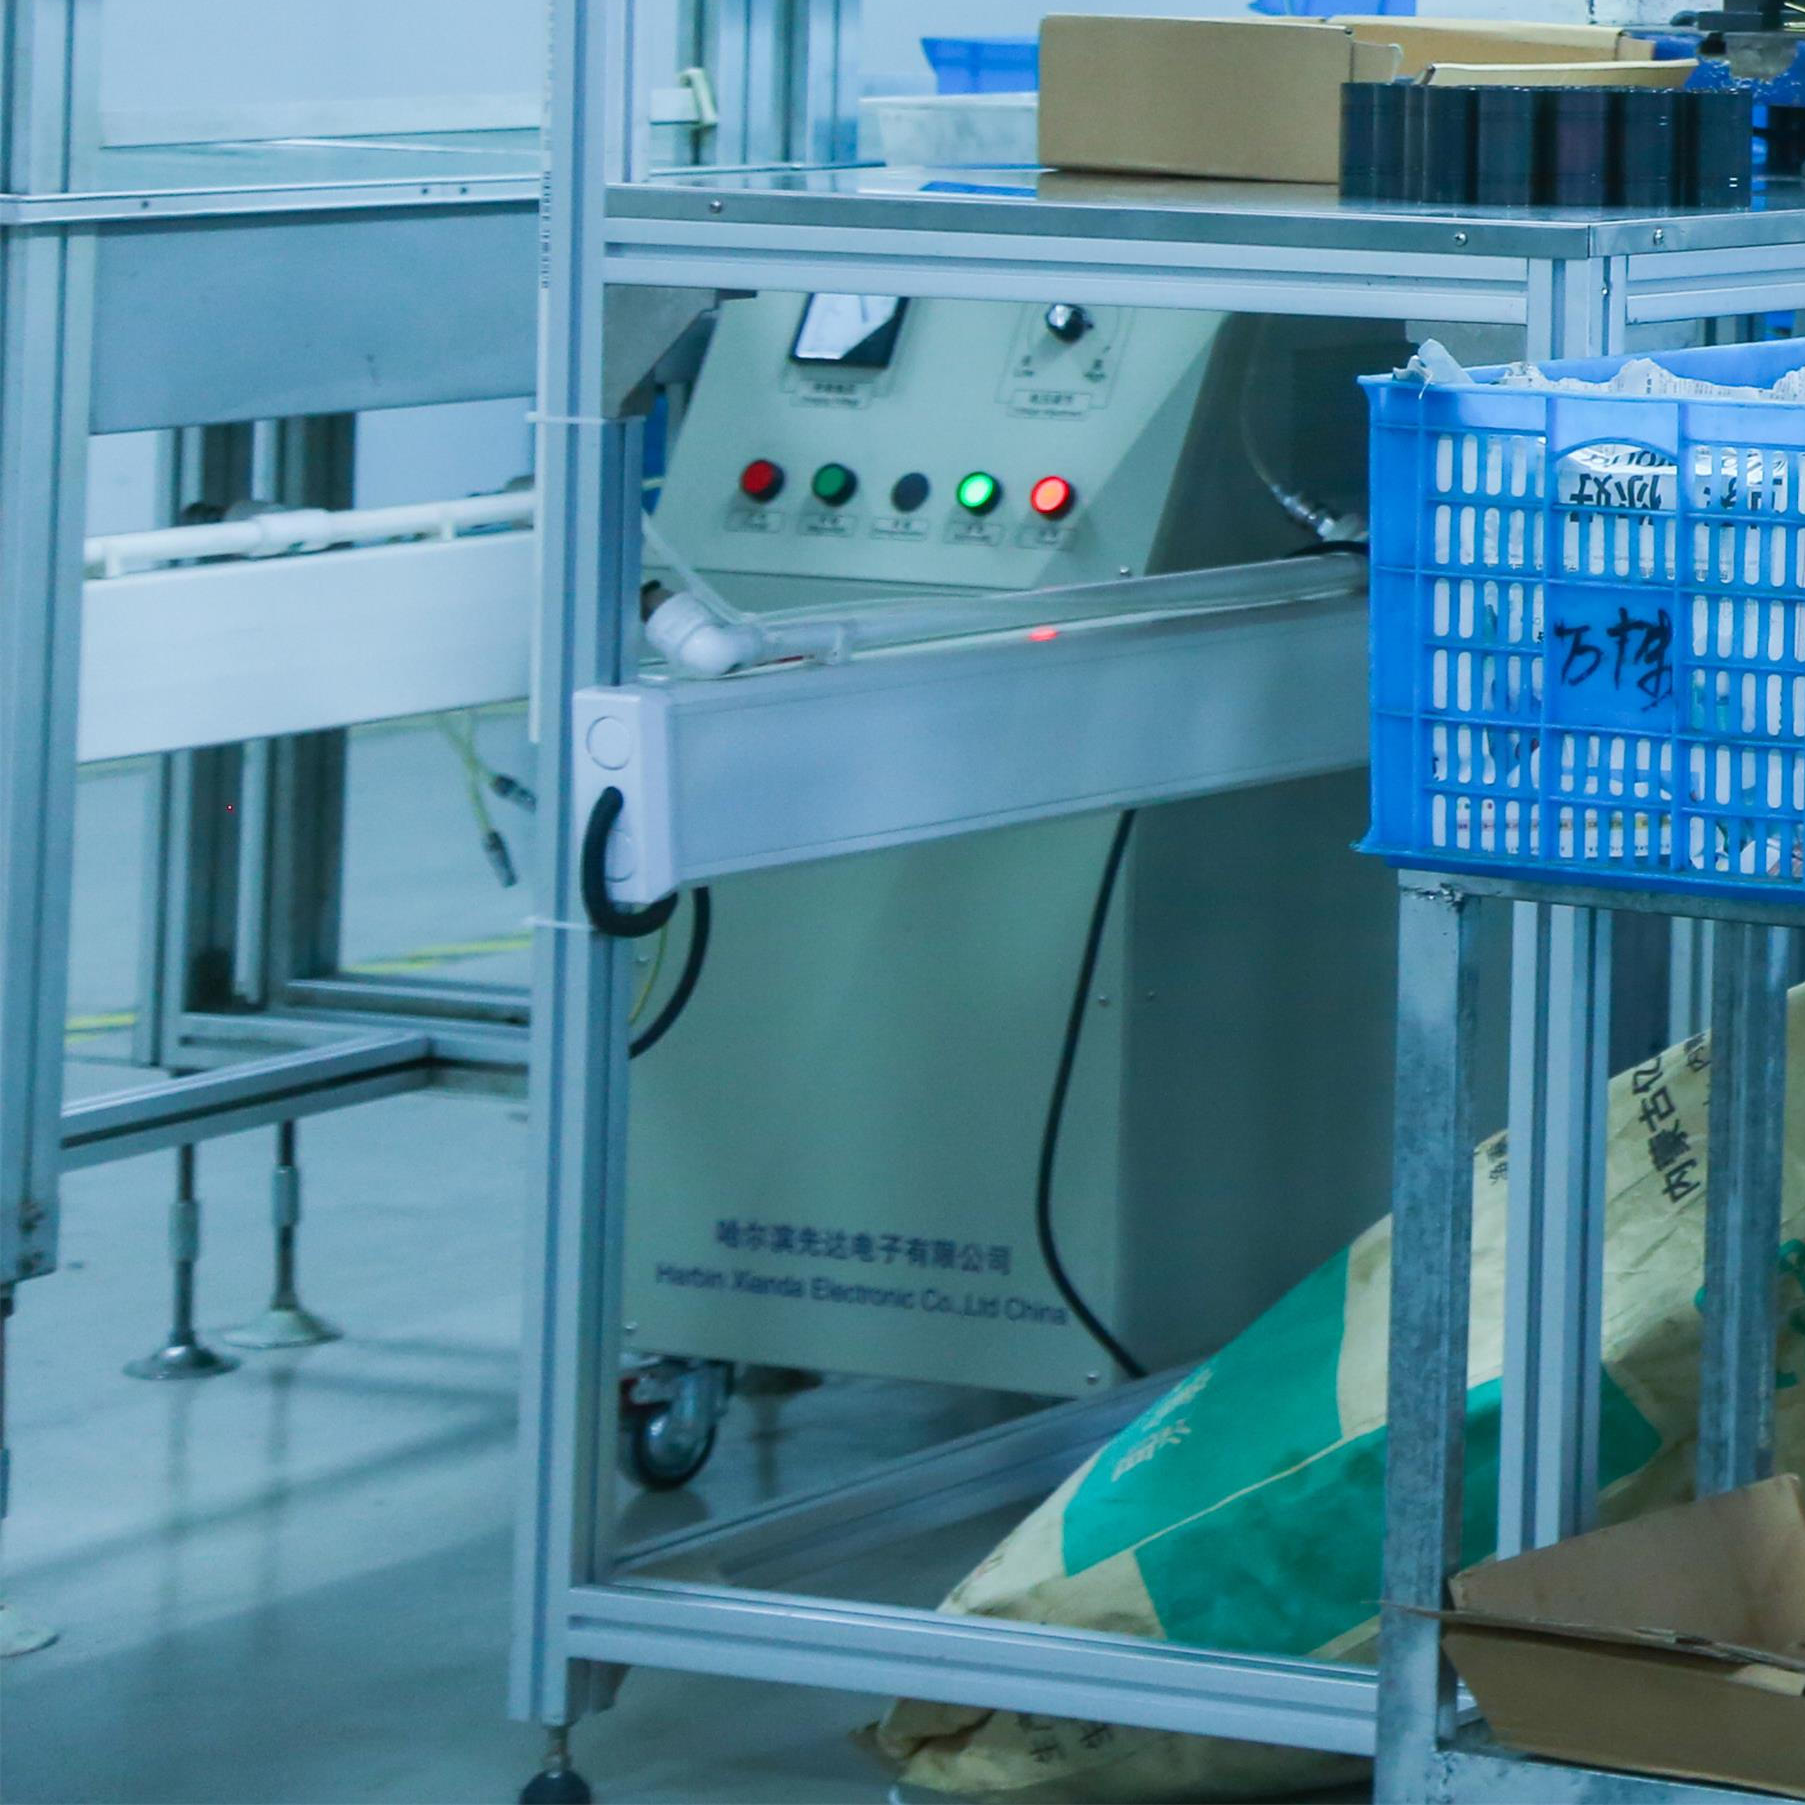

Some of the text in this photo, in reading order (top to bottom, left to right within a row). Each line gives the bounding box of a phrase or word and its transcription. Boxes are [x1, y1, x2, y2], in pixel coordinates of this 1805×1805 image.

[715, 1218, 1011, 1276] 哈尔滨先达电子有限公司
[656, 1262, 723, 1289] Harbin
[732, 1269, 803, 1298] Xianda
[811, 1276, 915, 1309] Electronic
[1004, 1297, 1069, 1326] China
